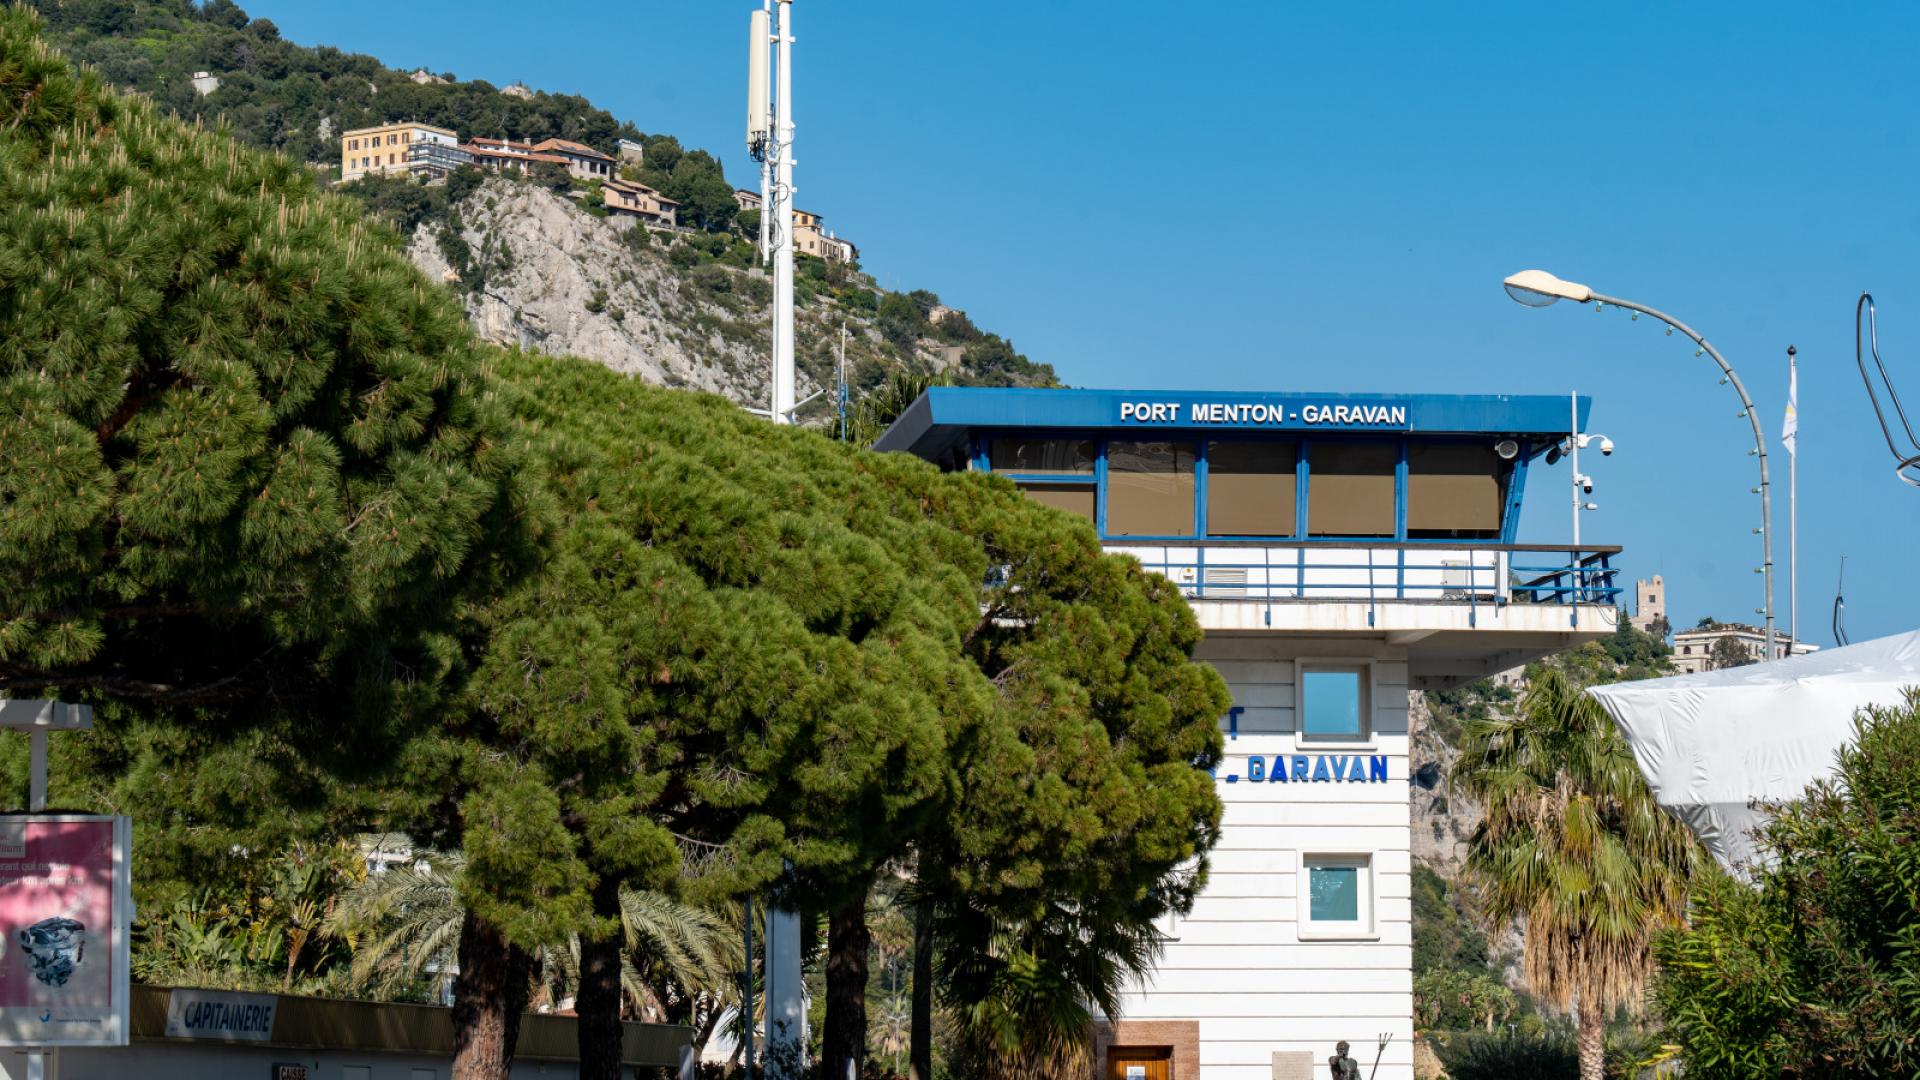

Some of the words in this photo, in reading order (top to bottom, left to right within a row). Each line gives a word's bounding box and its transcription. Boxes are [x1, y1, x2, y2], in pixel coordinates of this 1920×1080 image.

[1120, 402, 1180, 422] PORT
[1192, 403, 1283, 423] MENTON
[1302, 405, 1406, 425] GARAVAN
[1247, 755, 1388, 783] GARAVAN
[184, 1001, 272, 1032] CAPITAINERIE
